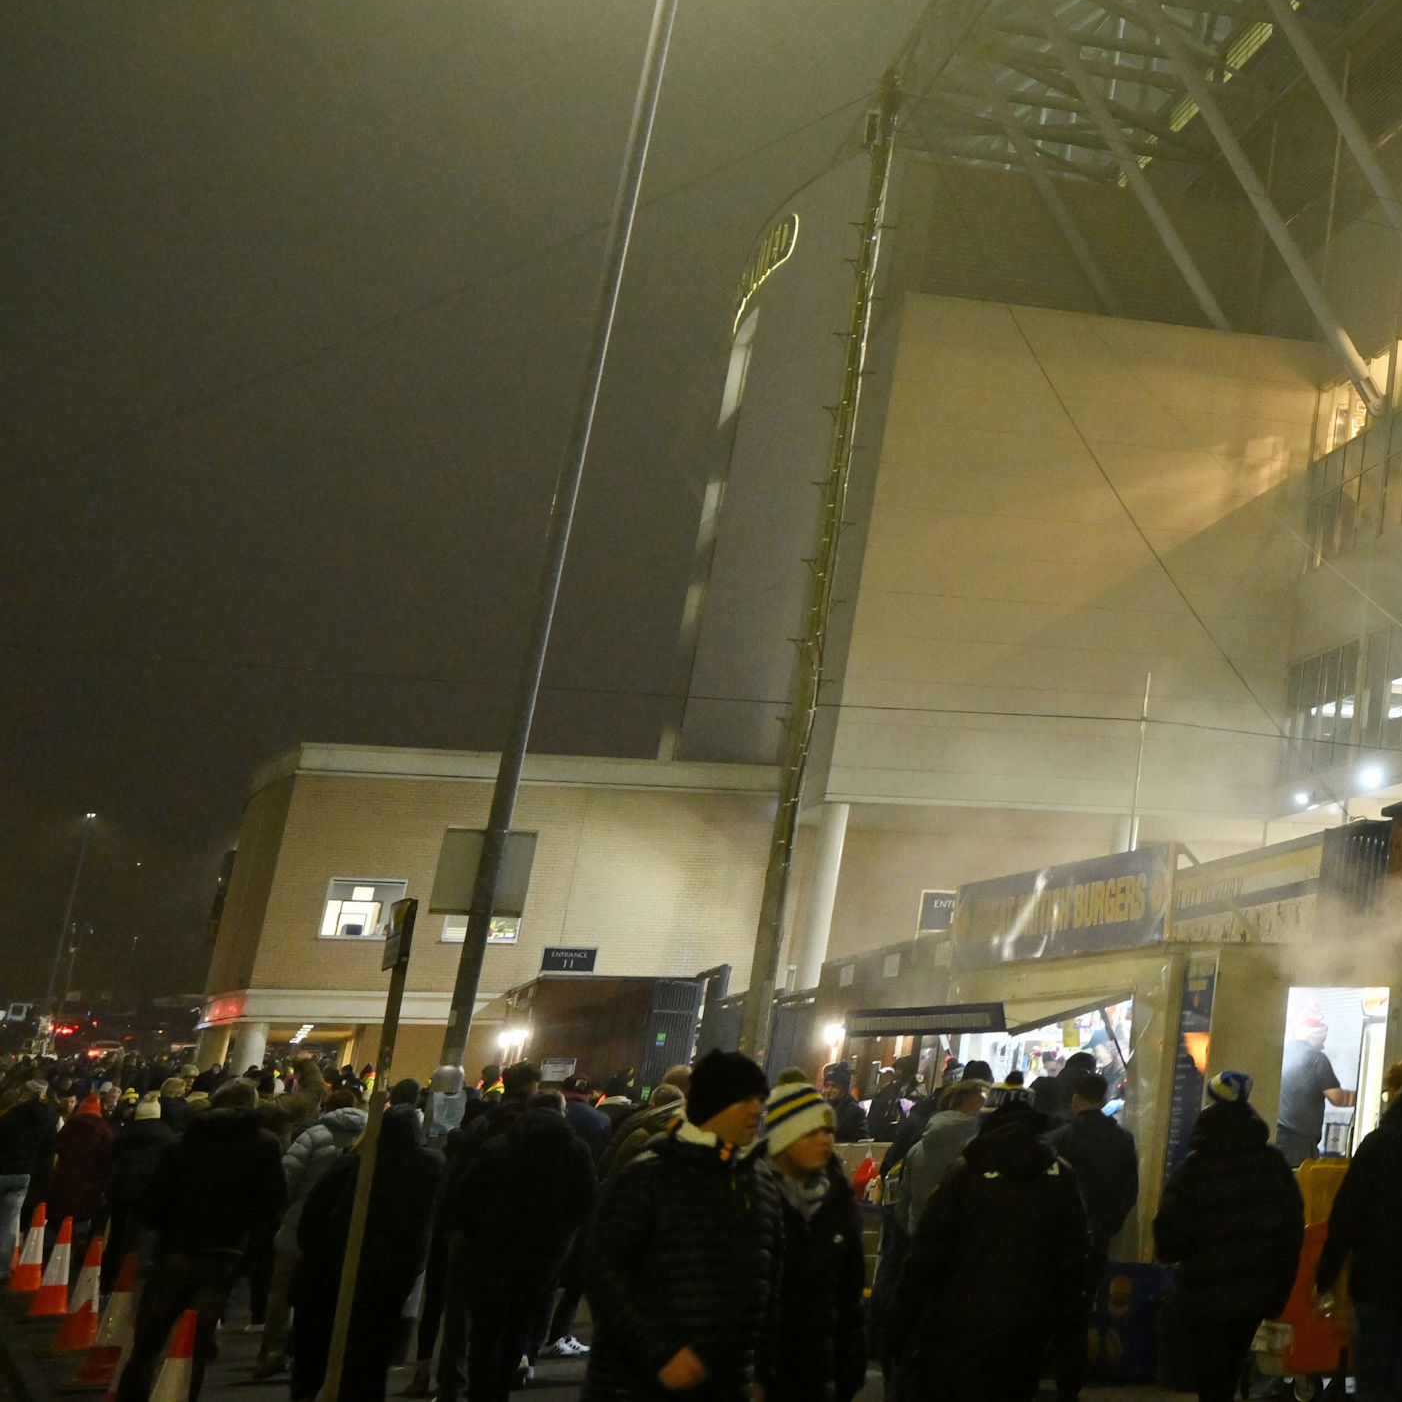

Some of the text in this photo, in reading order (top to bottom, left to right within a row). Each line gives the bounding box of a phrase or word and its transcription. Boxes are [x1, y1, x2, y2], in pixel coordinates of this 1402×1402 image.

[1073, 872, 1147, 930] BURGERS
[551, 951, 588, 959] ENTRANCE
[562, 958, 575, 969] 11
